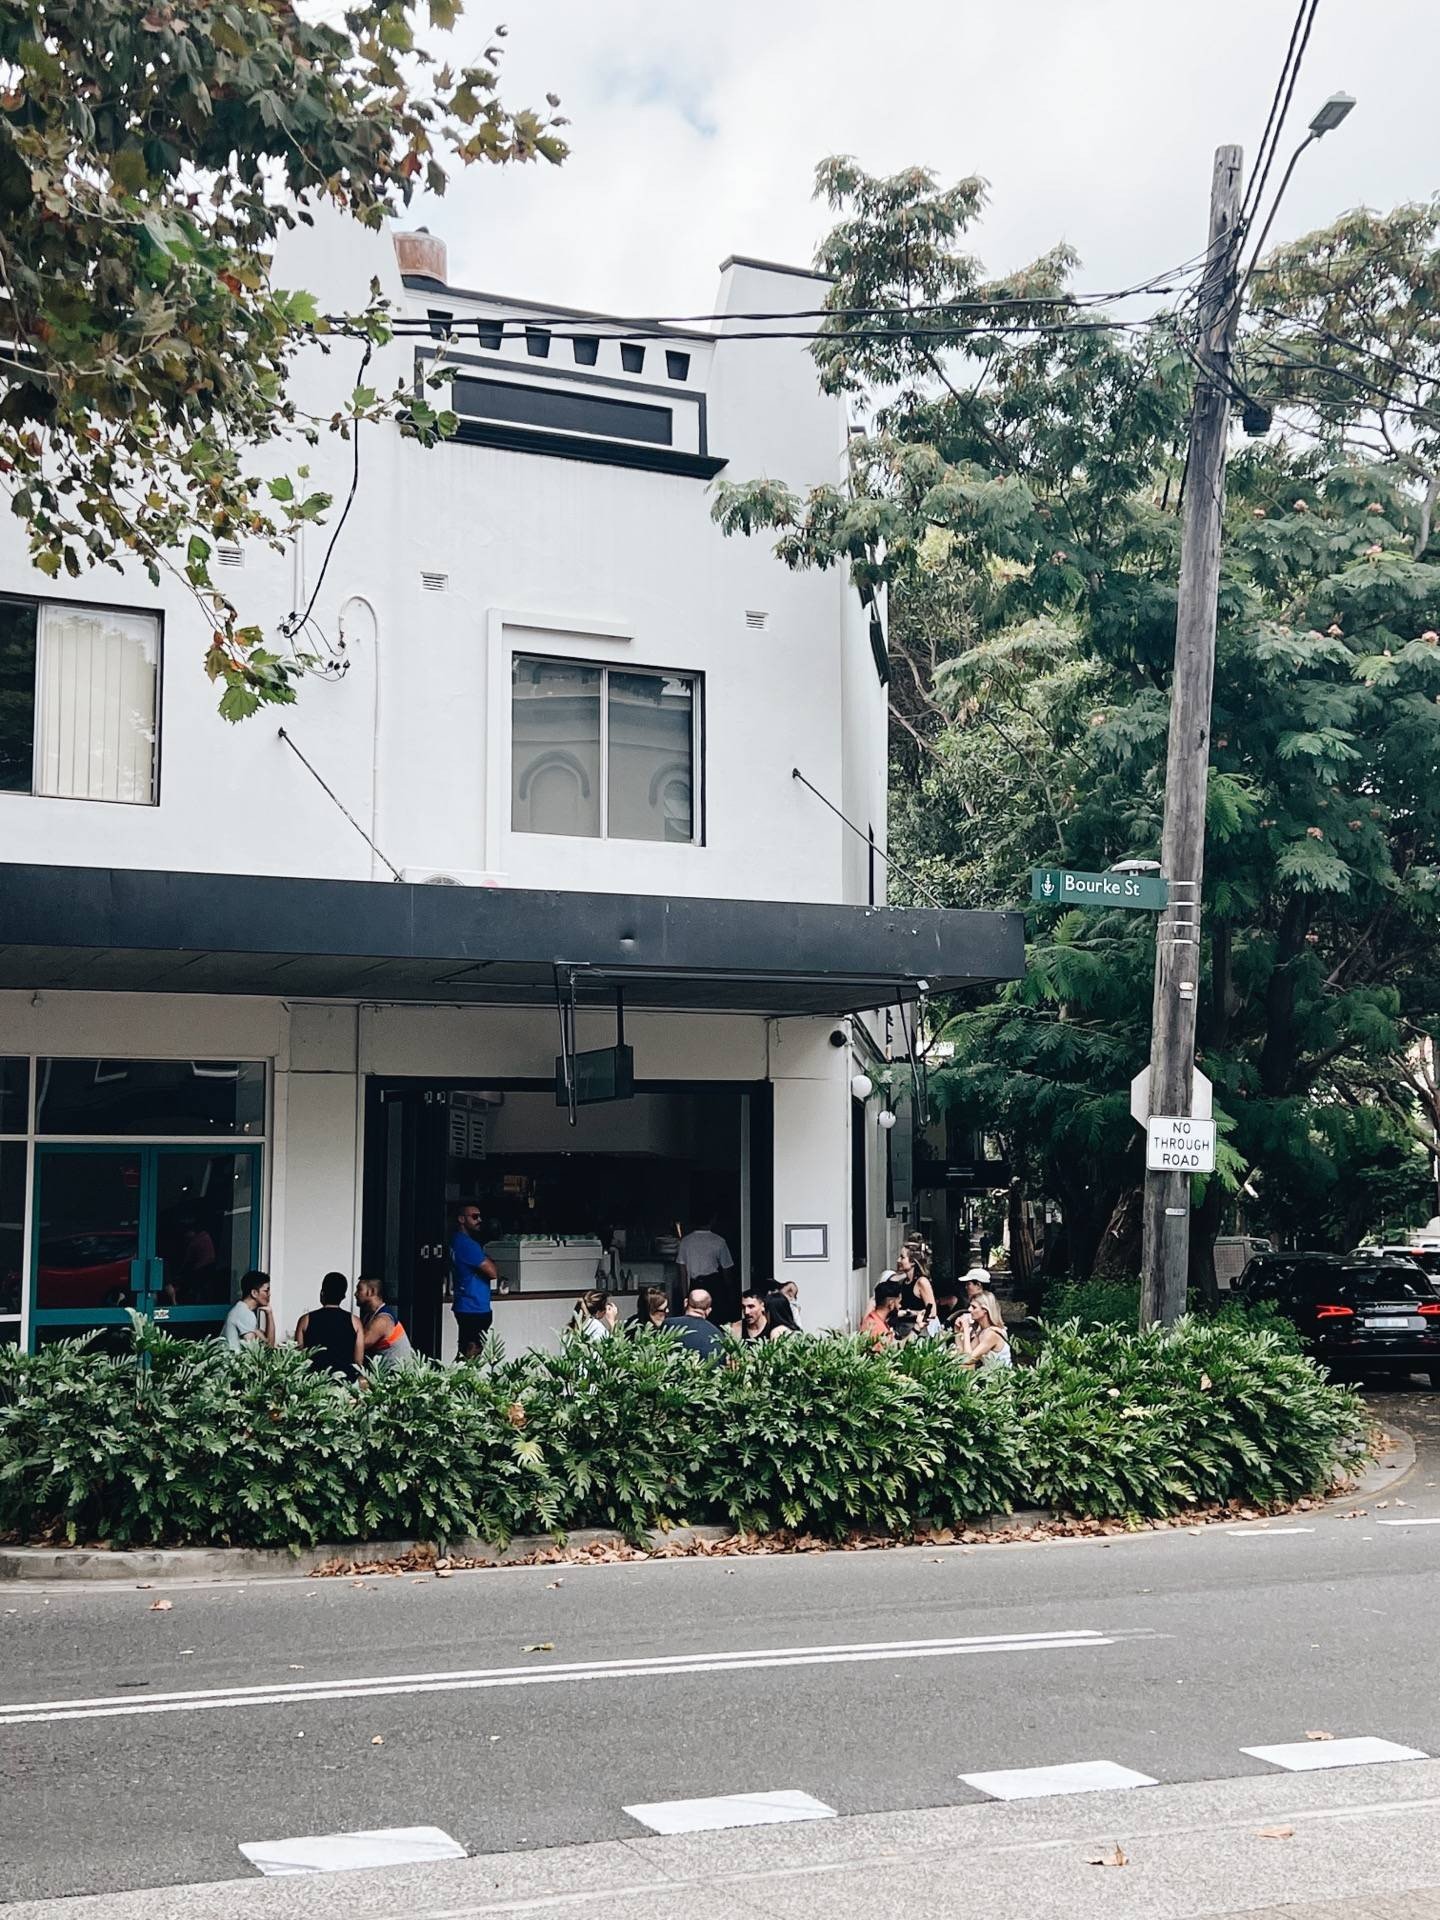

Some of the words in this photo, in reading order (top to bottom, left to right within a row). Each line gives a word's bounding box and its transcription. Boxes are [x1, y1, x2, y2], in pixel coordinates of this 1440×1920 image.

[1065, 875, 1120, 894] Bourke
[1124, 880, 1140, 896] St
[1173, 1122, 1191, 1134] NO
[1154, 1137, 1210, 1150] THROUGH
[1163, 1153, 1199, 1167] ROAD
